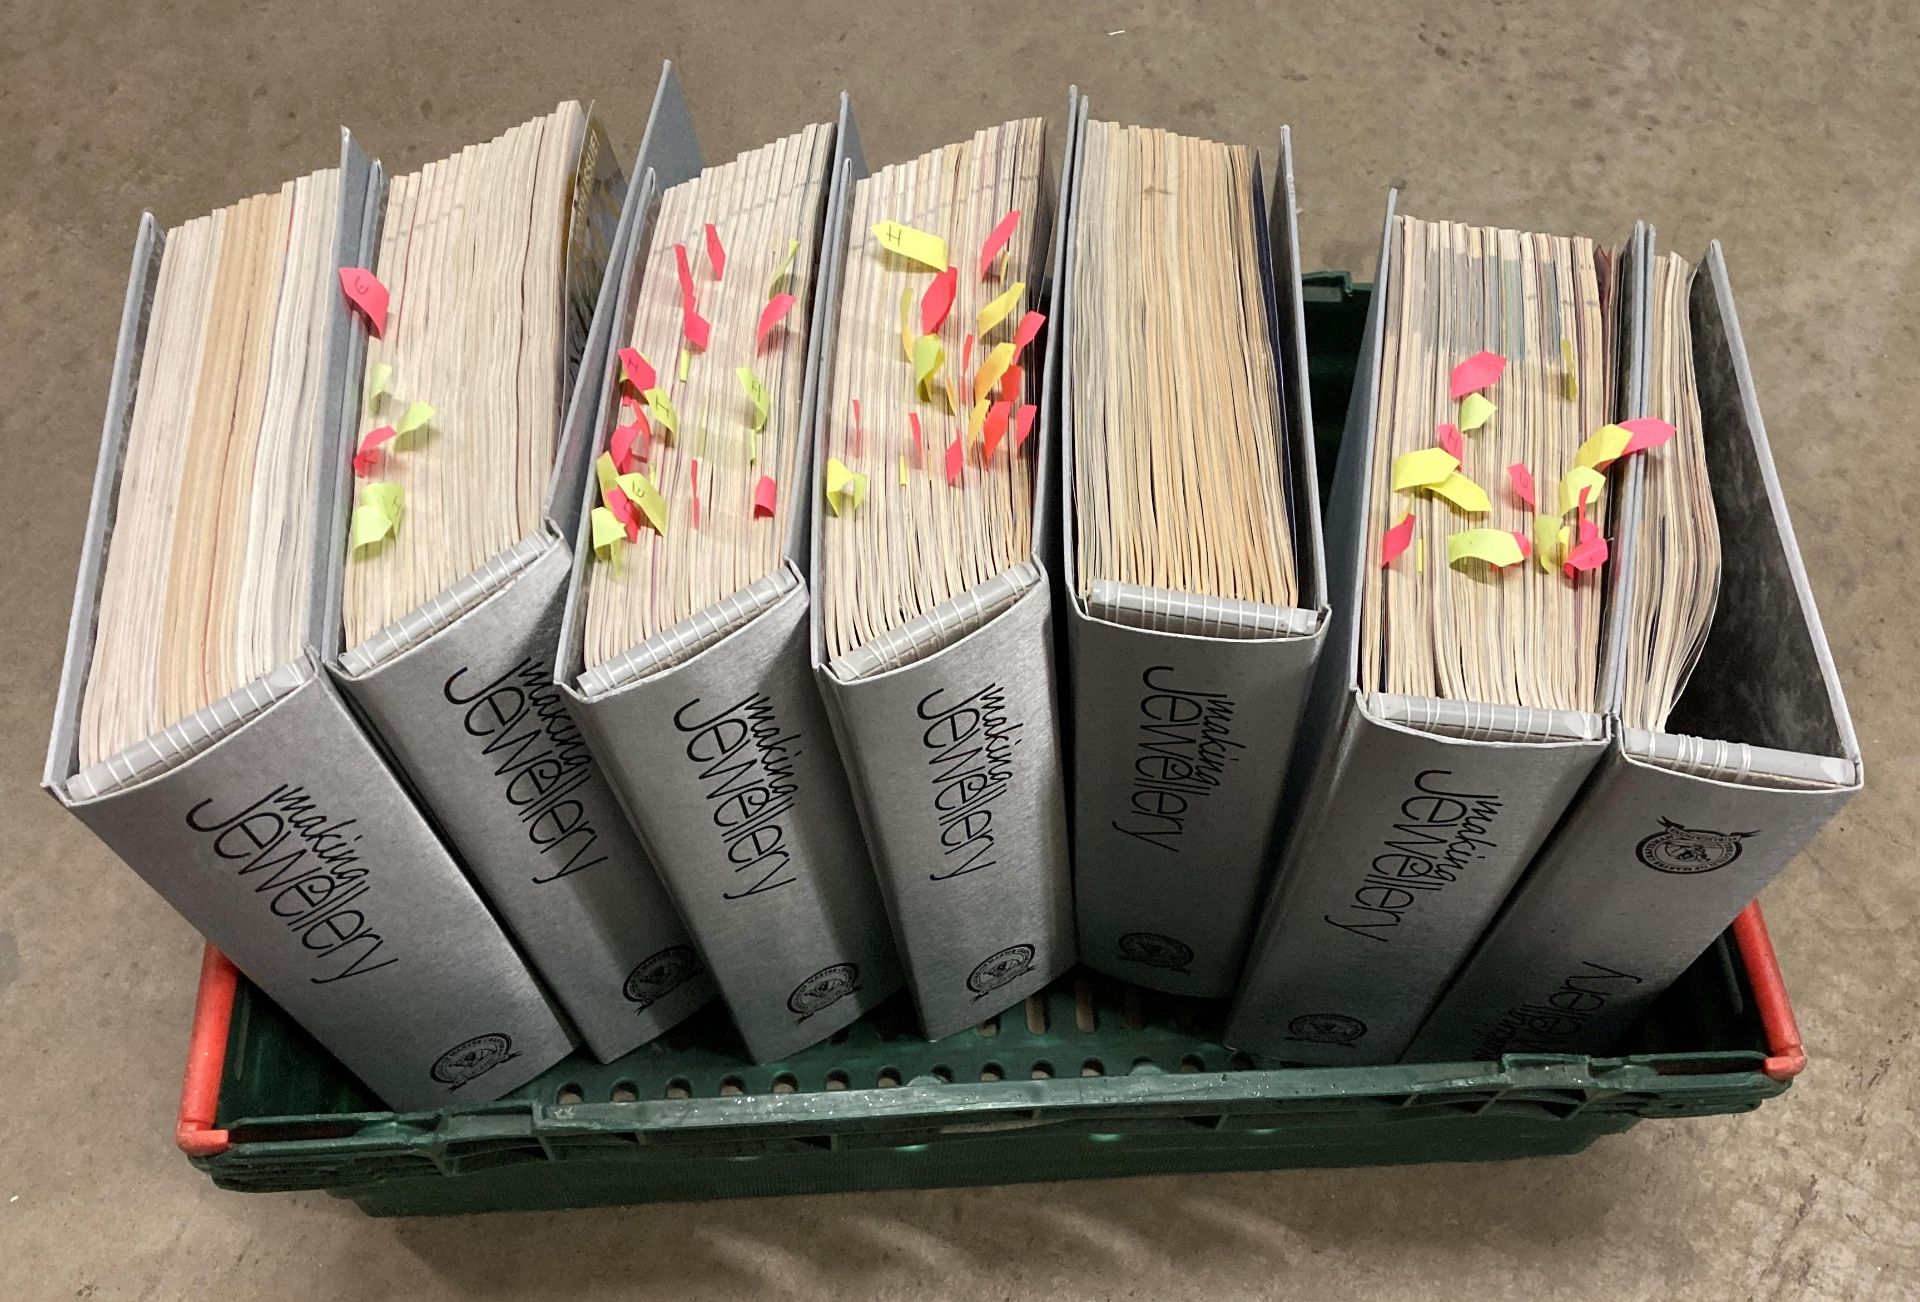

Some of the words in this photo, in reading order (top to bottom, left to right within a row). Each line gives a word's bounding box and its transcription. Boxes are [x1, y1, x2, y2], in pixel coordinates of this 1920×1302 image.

[886, 224, 902, 247] H
[444, 657, 608, 885] Jewellery
[673, 692, 797, 900] Jewellery
[745, 696, 802, 802] making
[917, 682, 997, 881] Jewellery
[980, 686, 1024, 787] making
[1111, 665, 1228, 853] Jewellery
[1194, 699, 1247, 788] making
[186, 784, 399, 984] Jewellery
[274, 786, 369, 887] making
[1324, 769, 1499, 943] Jewellery
[1427, 800, 1503, 883] making
